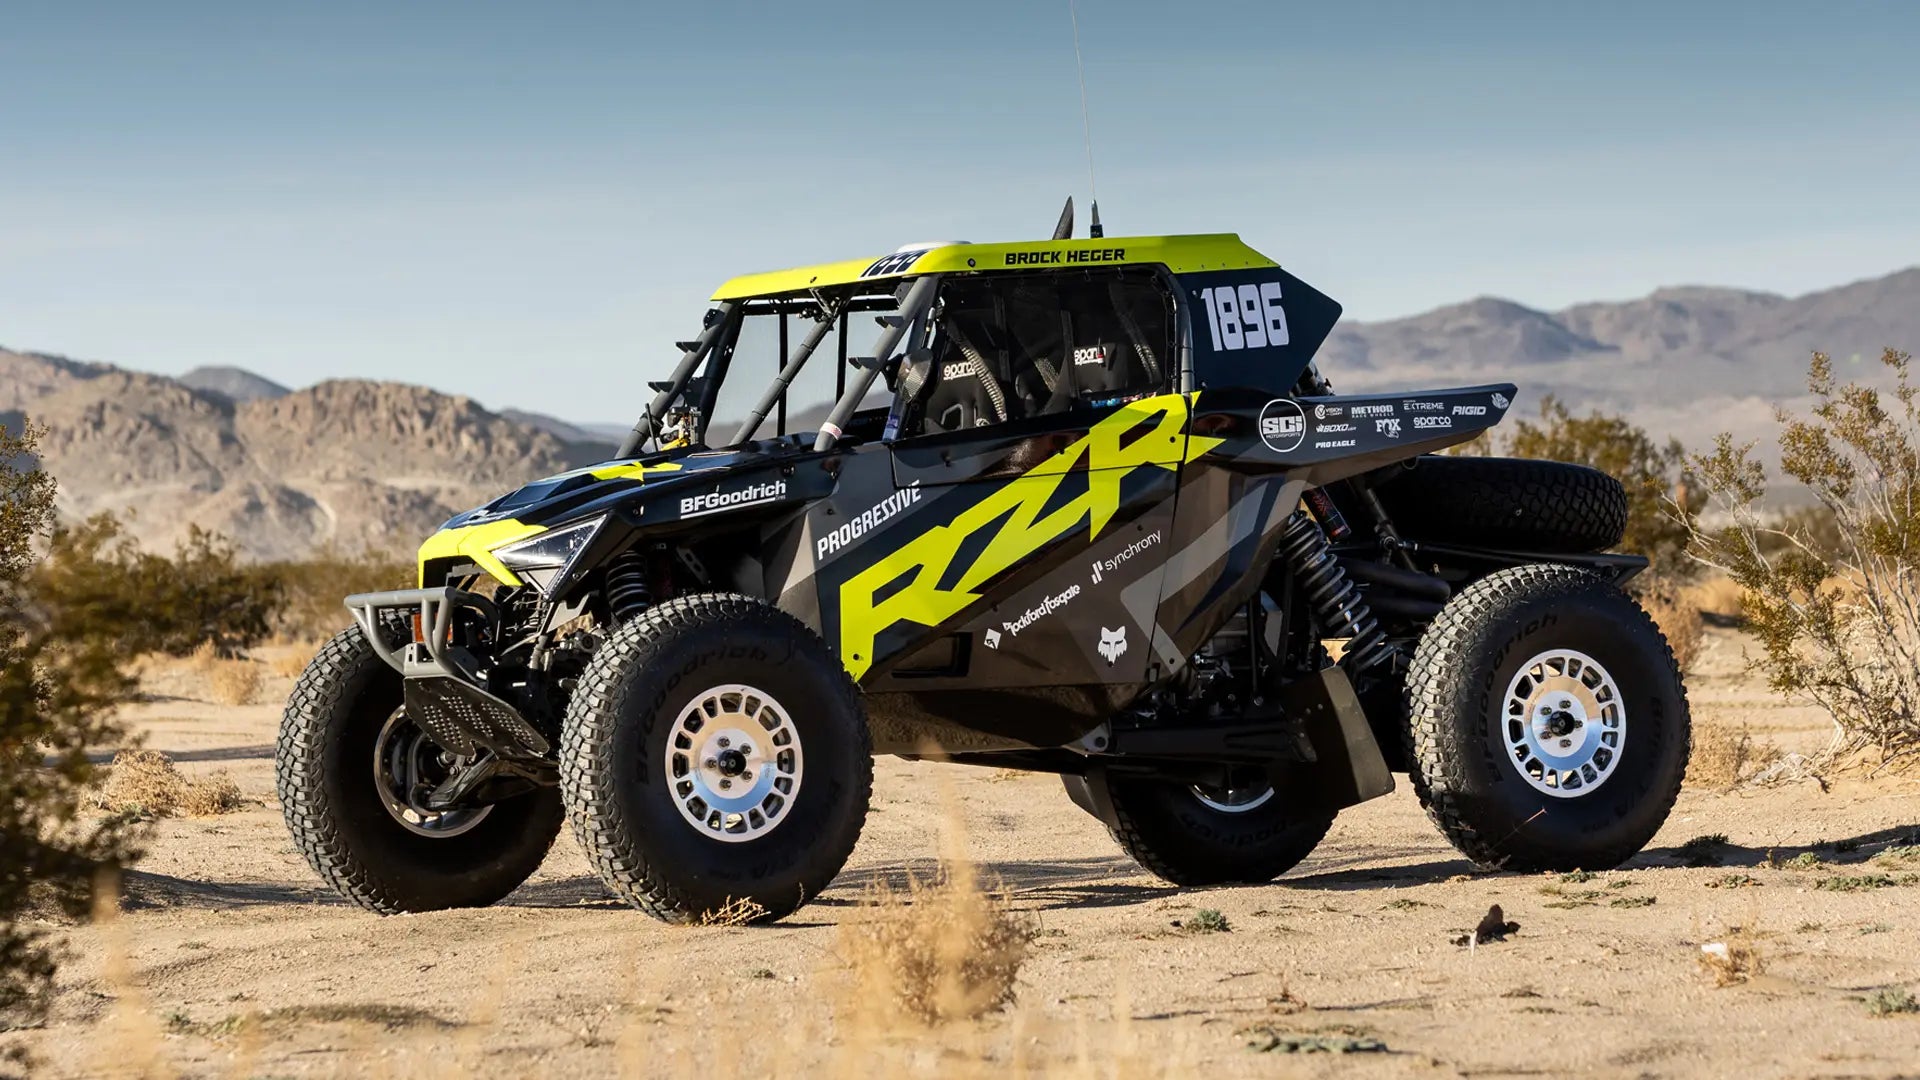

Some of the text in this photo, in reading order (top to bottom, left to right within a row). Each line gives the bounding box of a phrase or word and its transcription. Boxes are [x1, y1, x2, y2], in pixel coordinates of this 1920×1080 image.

[1005, 249, 1125, 265] BROCK HEGER
[1200, 282, 1289, 352] 1896
[1074, 347, 1106, 365] spar
[943, 361, 976, 381] sparc
[1351, 404, 1394, 415] METHOD
[1452, 405, 1487, 416] RIGID
[1375, 418, 1402, 438] FOX
[1413, 416, 1452, 428] sparco
[1315, 439, 1357, 449] PRO EAGLE
[680, 480, 786, 515] BFGoodrich
[817, 479, 922, 561] PROGRESSIVE
[840, 391, 1227, 682] RZR
[1104, 530, 1161, 571] synchrony
